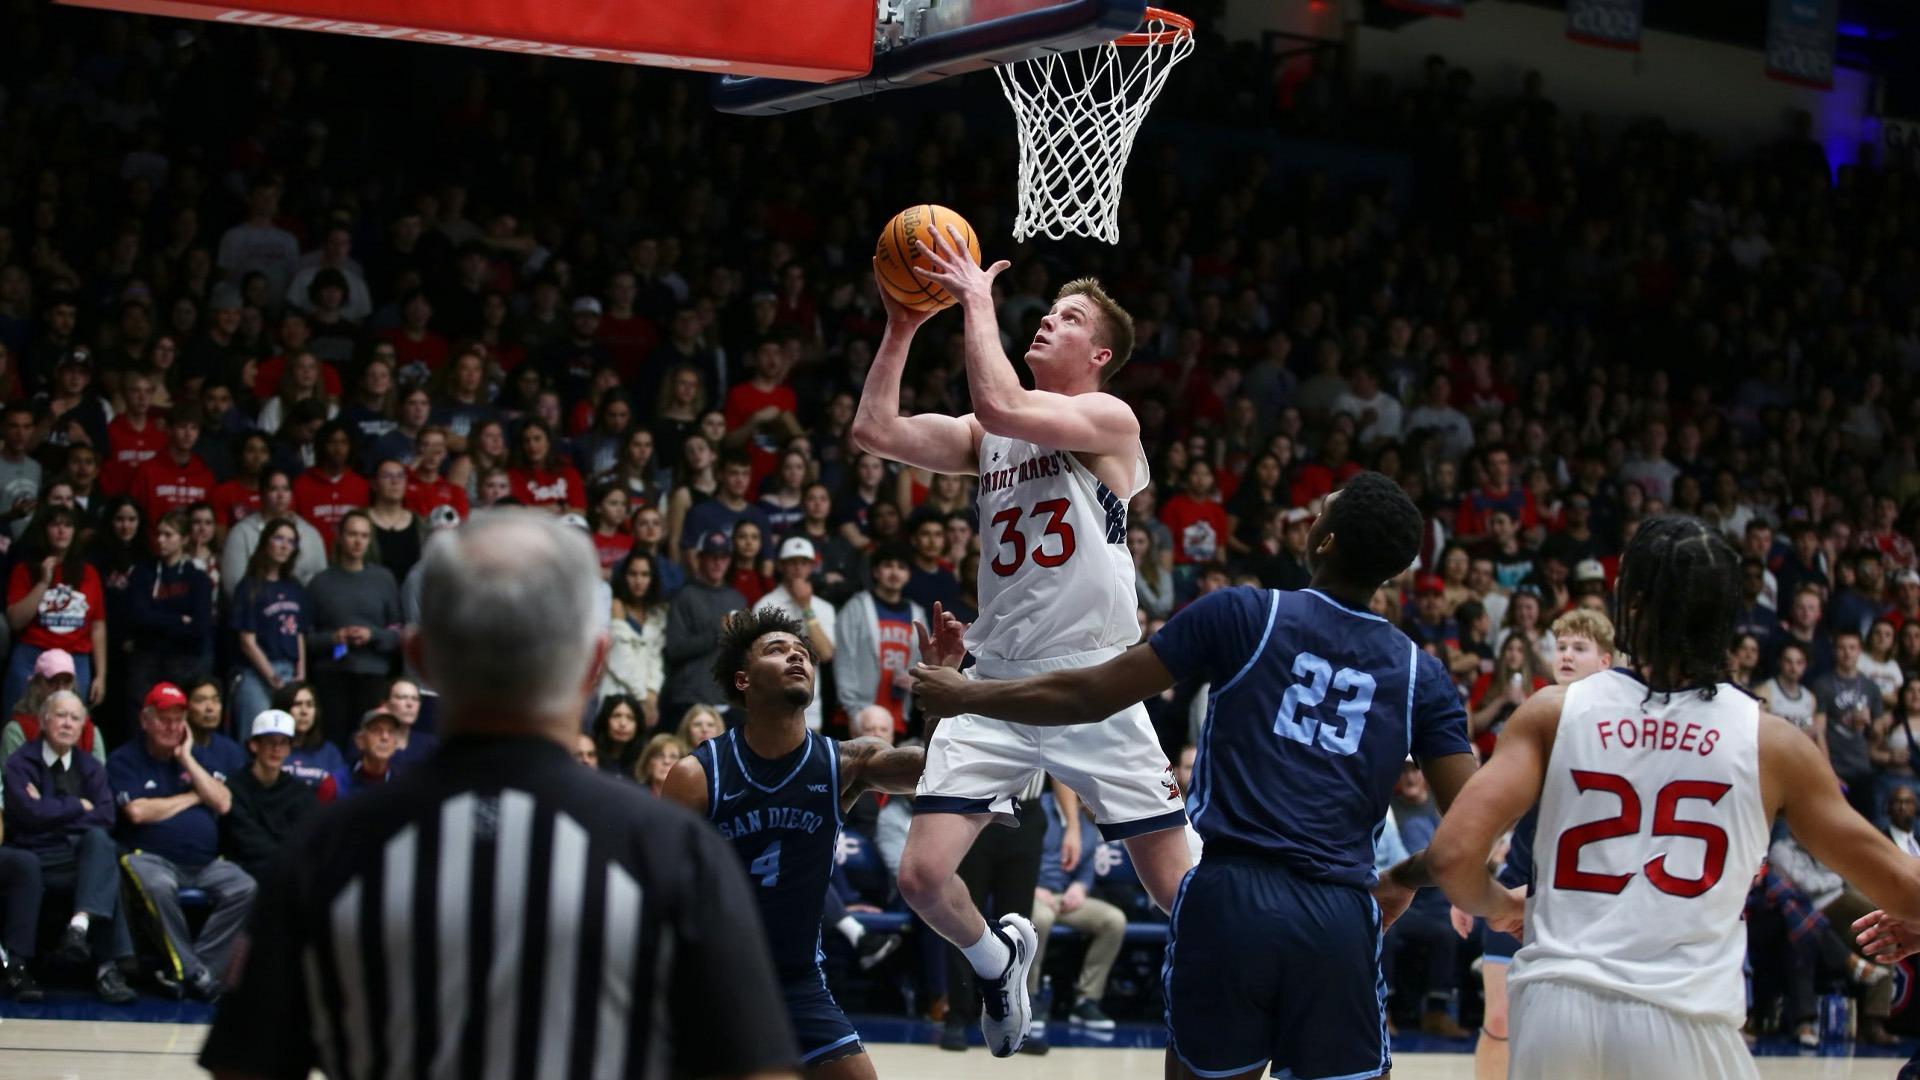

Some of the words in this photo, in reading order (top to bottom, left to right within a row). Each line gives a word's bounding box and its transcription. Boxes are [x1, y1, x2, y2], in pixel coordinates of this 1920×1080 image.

[990, 497, 1076, 577] 33
[1273, 651, 1377, 756] 23
[1596, 718, 1720, 757] FORBES
[719, 810, 762, 840] SAN
[767, 807, 823, 834] DIEGO
[1553, 768, 1734, 899] 25
[750, 840, 781, 887] 4
